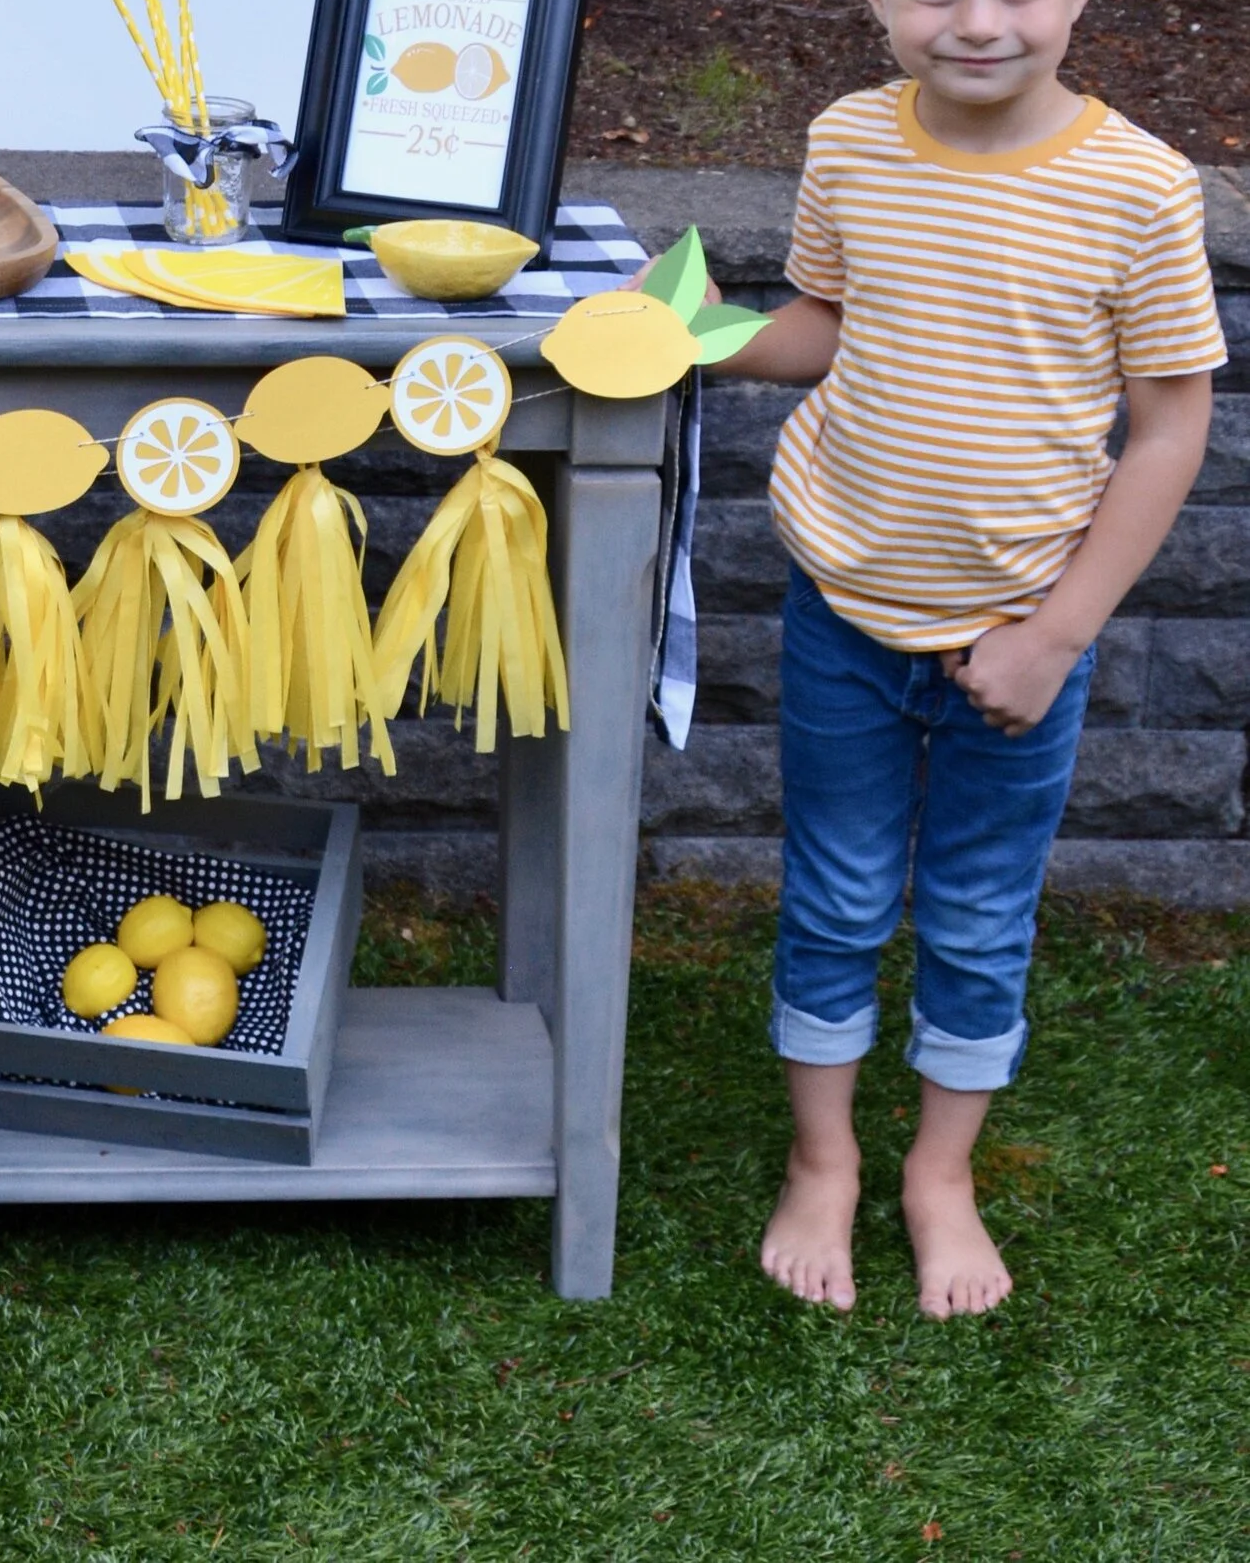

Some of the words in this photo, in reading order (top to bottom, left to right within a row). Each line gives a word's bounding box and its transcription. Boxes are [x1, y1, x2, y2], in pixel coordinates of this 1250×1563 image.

[376, 2, 523, 48] LEMONADE
[368, 97, 417, 118] FRESH
[422, 101, 502, 125] SQUEEZED
[405, 123, 460, 161] 25¢
